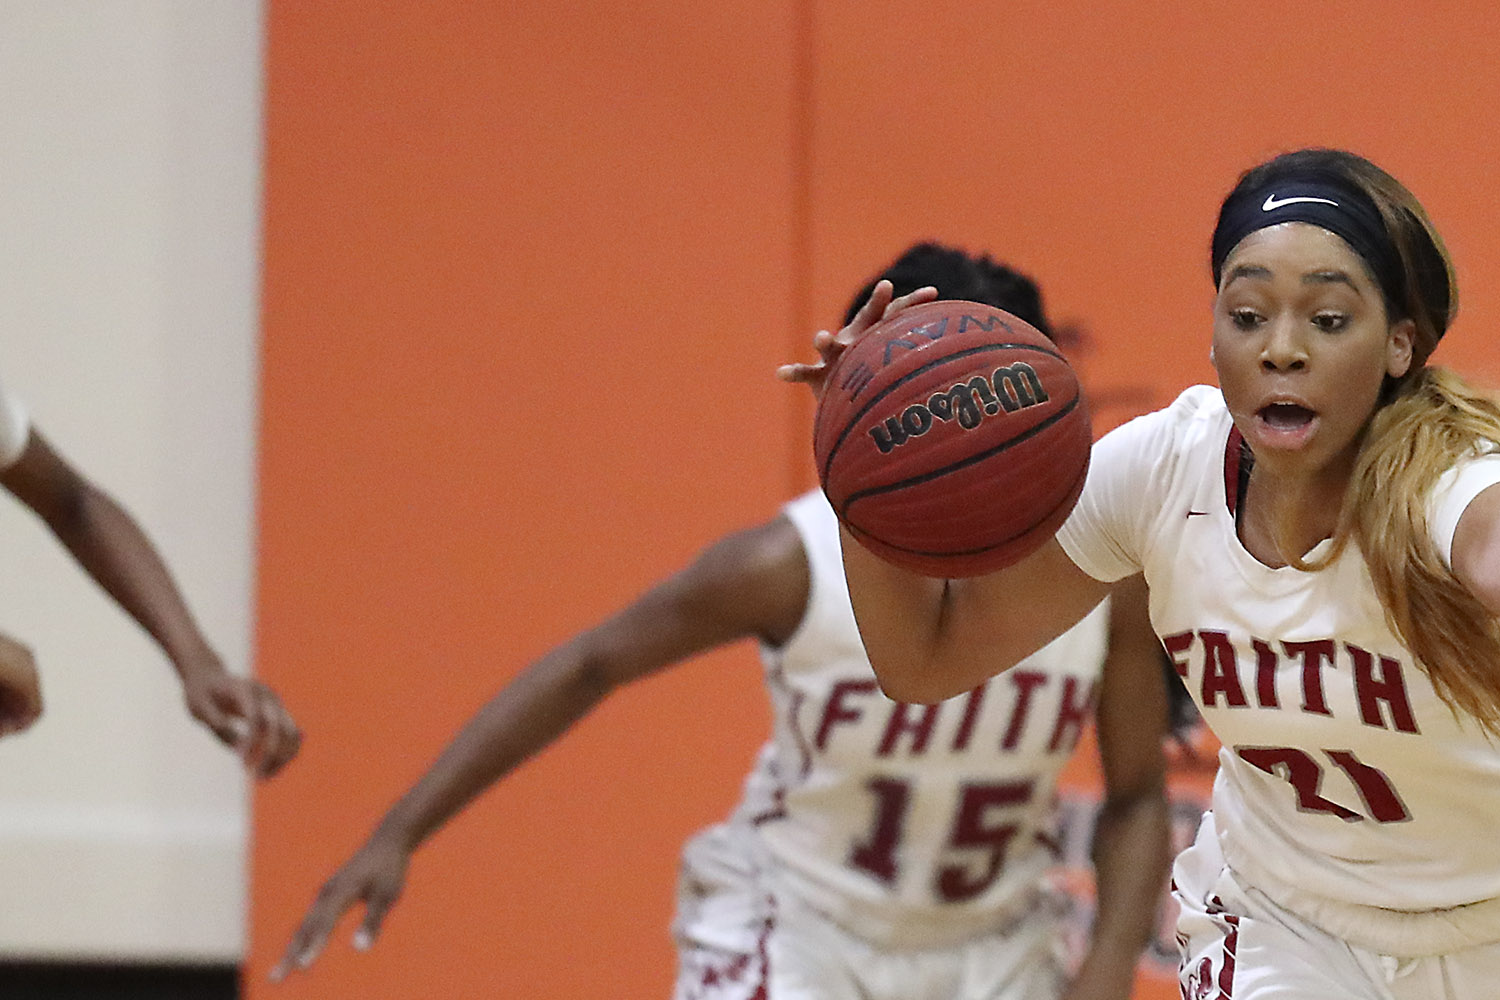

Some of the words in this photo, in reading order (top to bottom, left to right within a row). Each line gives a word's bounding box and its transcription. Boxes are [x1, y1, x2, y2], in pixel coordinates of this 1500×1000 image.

[867, 361, 1050, 455] Wilson
[1232, 744, 1414, 825] 21
[848, 776, 1037, 903] 15
